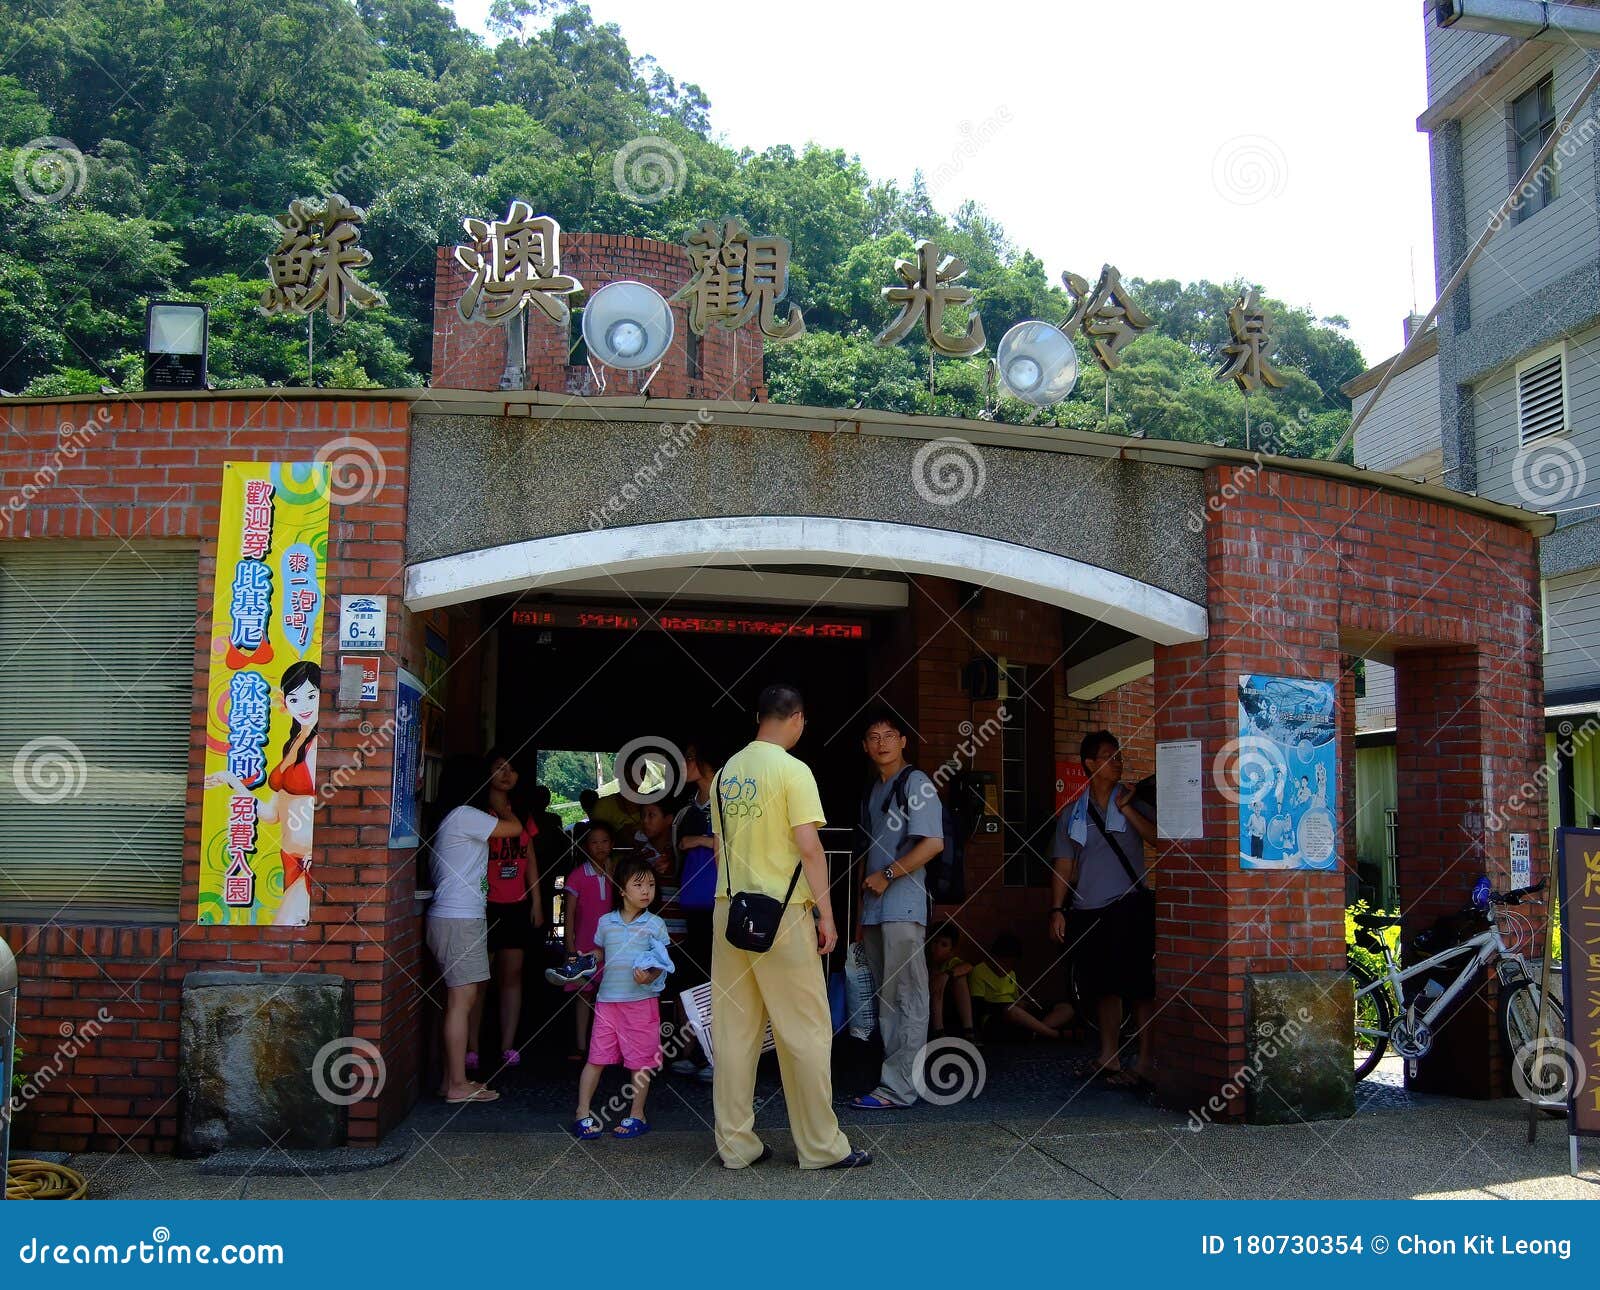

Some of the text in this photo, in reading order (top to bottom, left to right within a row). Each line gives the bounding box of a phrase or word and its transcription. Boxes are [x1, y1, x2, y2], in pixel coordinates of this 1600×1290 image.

[260, 193, 1286, 393] 蘇澳觀光冷泉
[349, 621, 376, 639] 6-4
[229, 672, 268, 788] 泳裝女郎
[225, 796, 256, 906] 免費入園
